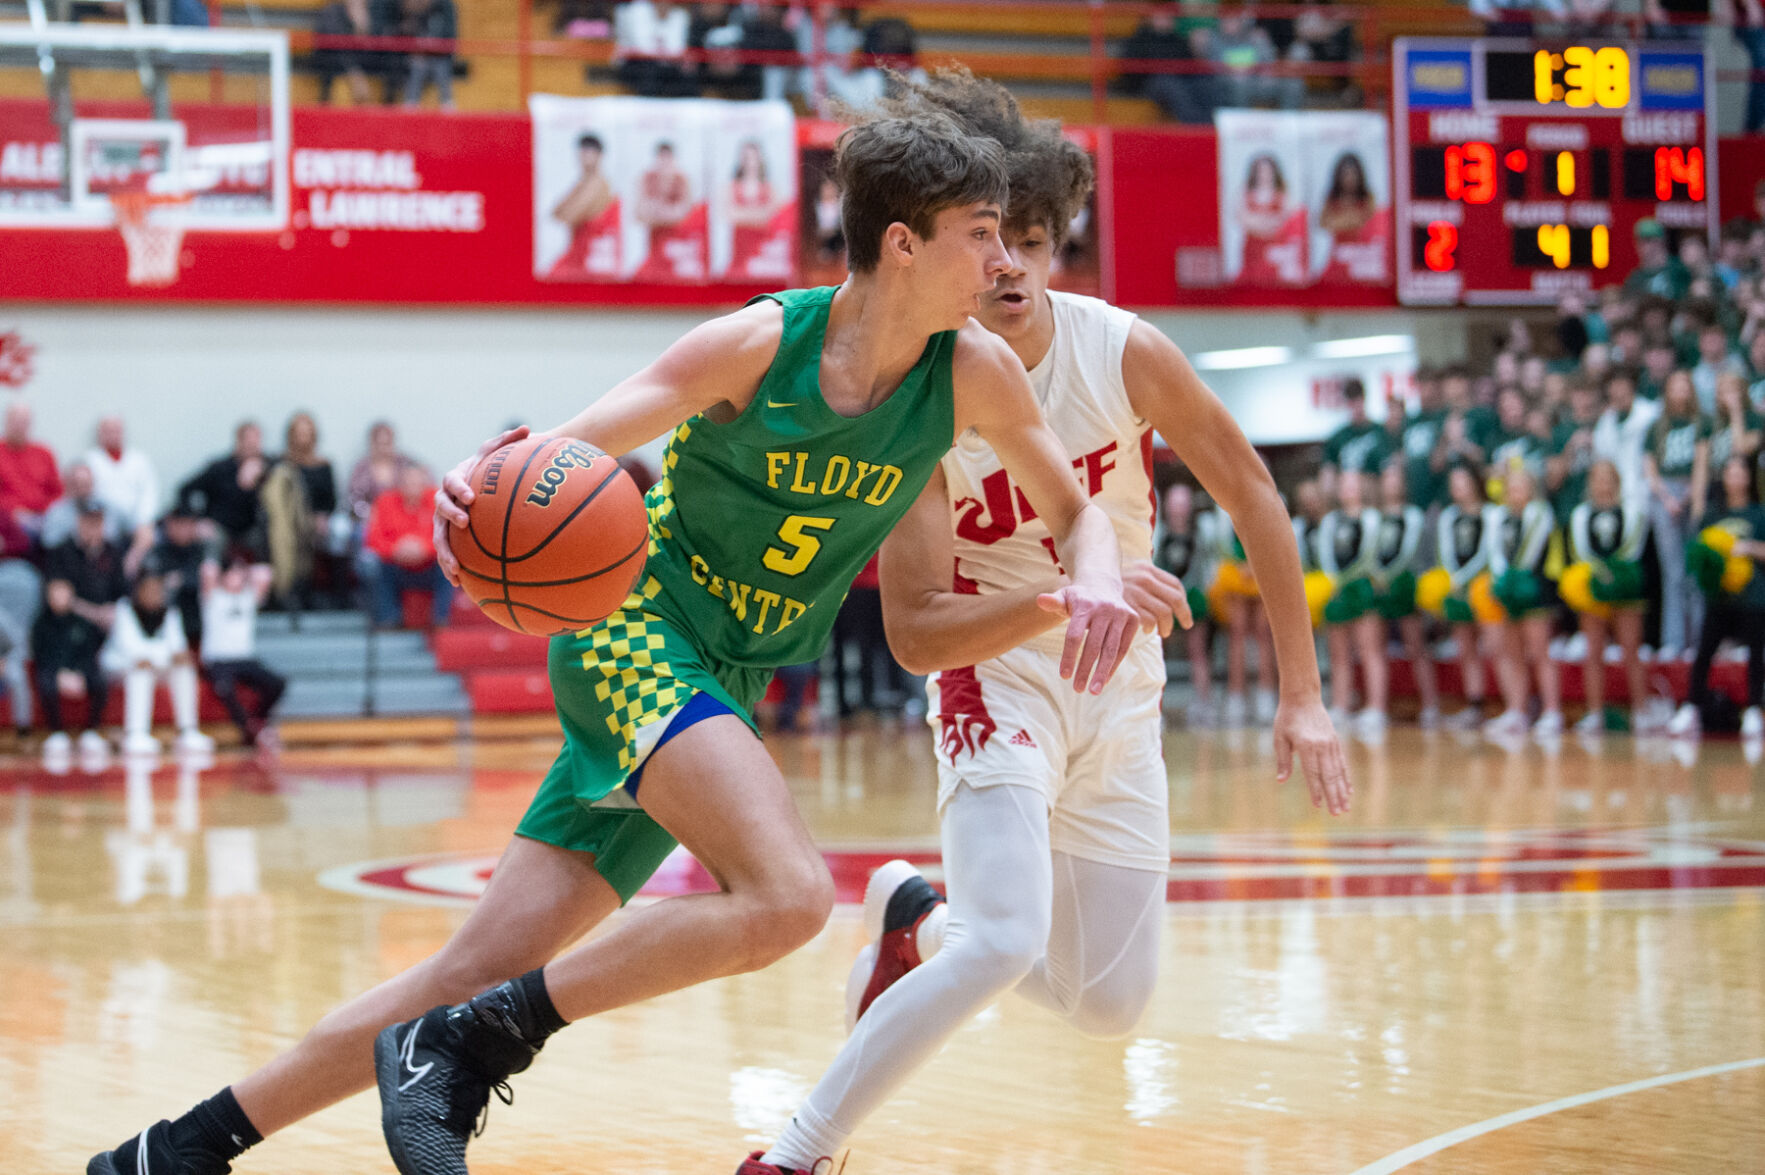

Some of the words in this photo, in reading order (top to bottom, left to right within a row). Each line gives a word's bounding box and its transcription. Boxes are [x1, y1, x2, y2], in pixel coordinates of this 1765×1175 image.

[1534, 47, 1630, 108] 1:38
[294, 149, 420, 187] ENTRAL
[1444, 142, 1497, 205] 13
[1557, 151, 1575, 196] 1
[1654, 146, 1705, 201] 14
[310, 191, 484, 231] LAWRENCE
[1424, 220, 1459, 272] 2
[765, 451, 904, 507] FLOYD
[953, 440, 1117, 546] JF
[761, 513, 839, 577] 5
[691, 554, 816, 636] CENTR
